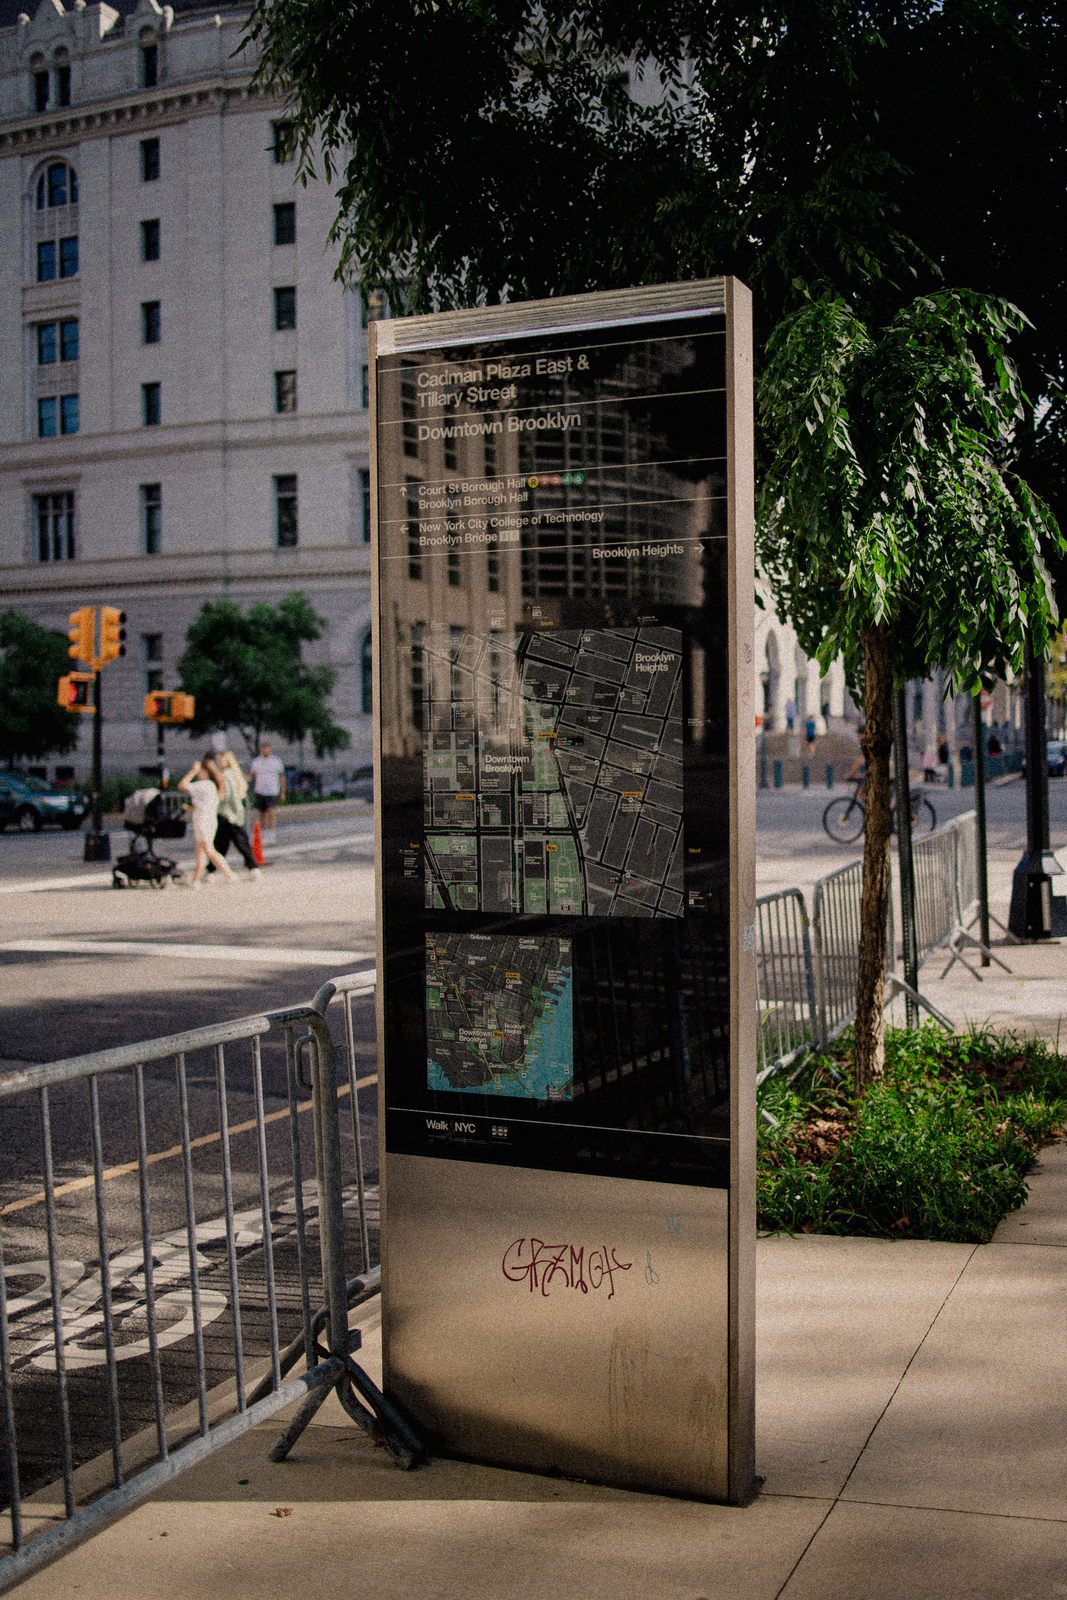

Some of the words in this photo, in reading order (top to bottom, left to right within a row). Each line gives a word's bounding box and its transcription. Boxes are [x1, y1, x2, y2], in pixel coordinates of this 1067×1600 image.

[417, 370, 483, 388] Cadman
[486, 364, 531, 381] Plaza
[536, 356, 574, 375] East
[576, 354, 590, 370] &
[417, 391, 463, 408] Tillary
[466, 383, 517, 402] Street
[418, 421, 503, 441] Downtown
[507, 411, 582, 432] Brooklyn
[418, 485, 447, 496] Court
[448, 483, 459, 494] St
[461, 479, 505, 493] Borough
[507, 478, 526, 489] Hall
[418, 499, 461, 510] Brooklyn
[463, 492, 507, 507] Borough
[509, 491, 528, 503] Hall
[418, 522, 441, 533] New
[443, 519, 465, 531] York
[467, 516, 488, 530] City
[490, 514, 529, 528] College
[531, 513, 543, 525] of
[543, 511, 604, 524] Technology
[418, 534, 462, 547] Brooklyn
[464, 530, 498, 545] Bridge
[592, 546, 640, 559] Brooklyn
[641, 543, 684, 558] Heights
[635, 652, 675, 664] Brooklyn
[635, 662, 669, 674] Heights
[485, 754, 530, 764] Downtown
[485, 763, 522, 775] Brooklyn
[458, 1028, 491, 1038] Downtown
[458, 1034, 487, 1044] Brooklyn
[425, 1119, 449, 1131] Walk
[454, 1121, 476, 1134] NYC
